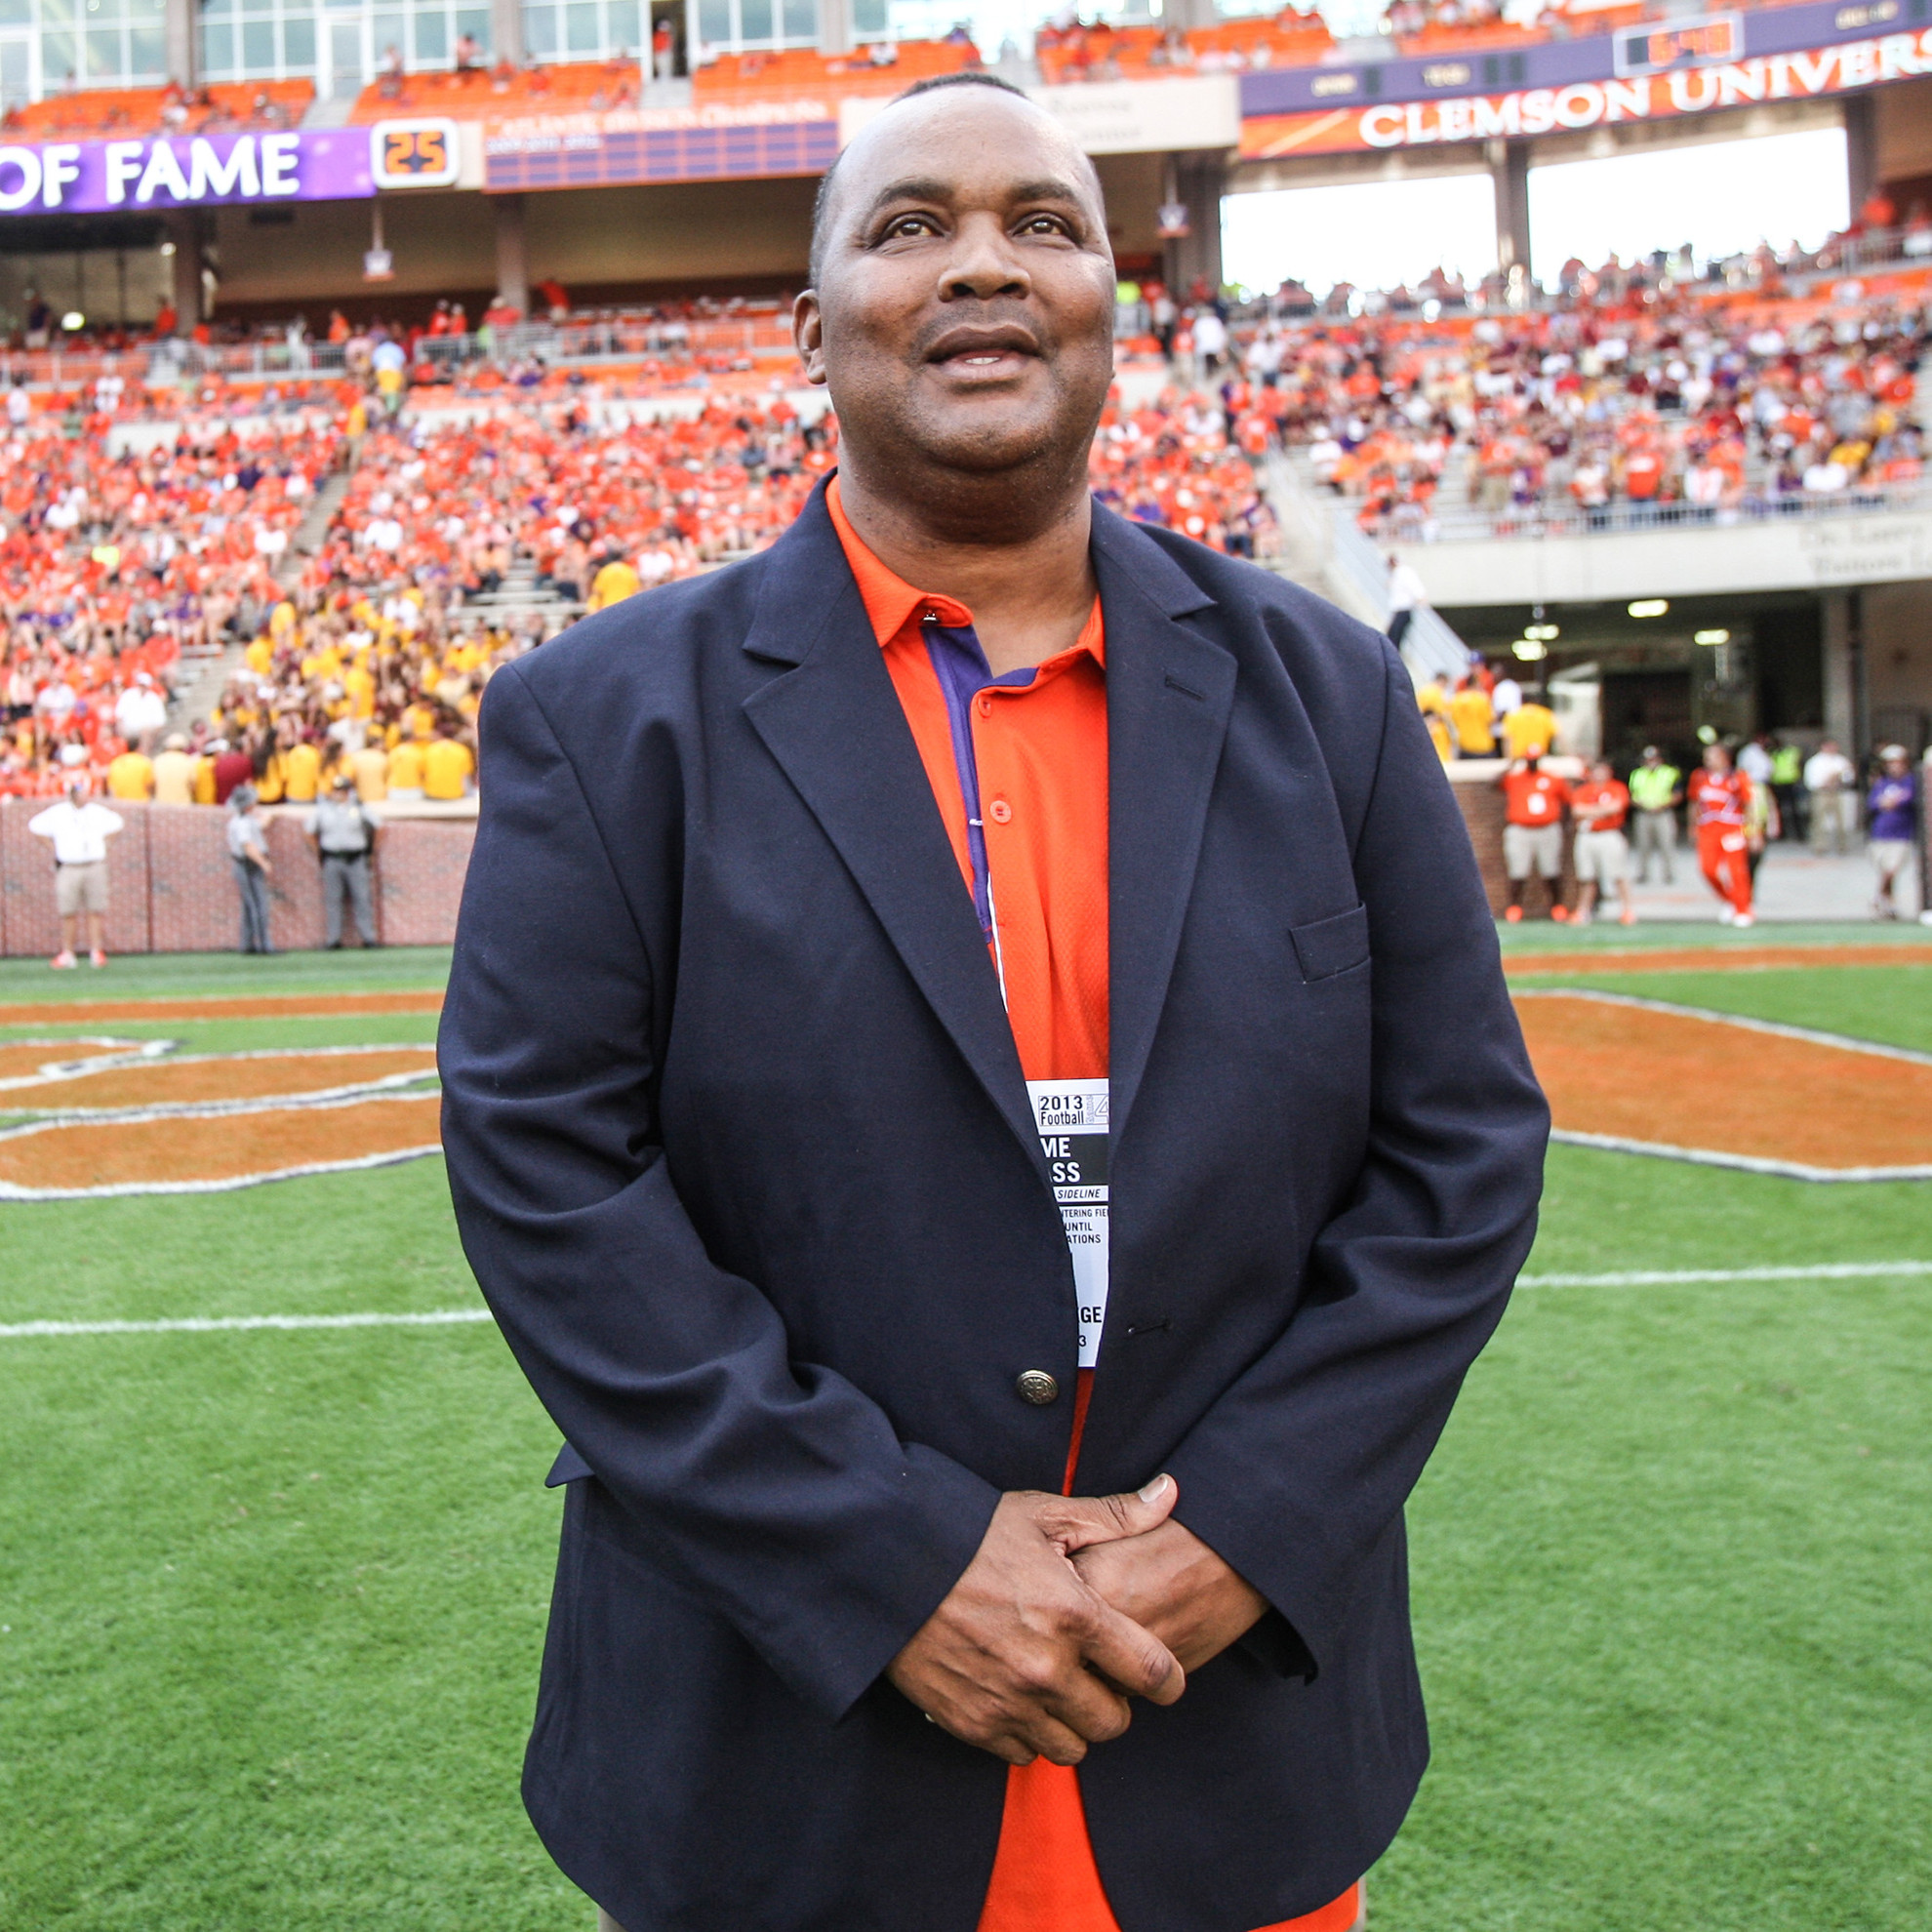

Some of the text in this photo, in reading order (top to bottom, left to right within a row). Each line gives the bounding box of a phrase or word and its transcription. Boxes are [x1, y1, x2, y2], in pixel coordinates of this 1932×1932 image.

[1358, 76, 1650, 148] CLEMSON
[384, 130, 447, 174] 25
[0, 132, 301, 212] OF FAME
[1040, 1096, 1083, 1110] 2013
[1040, 1110, 1084, 1126] Football
[1048, 1161, 1081, 1183] SS
[1057, 1188, 1102, 1199] SIDELINE
[1095, 1207, 1108, 1218] FIE
[1064, 1222, 1093, 1231] UNTIL
